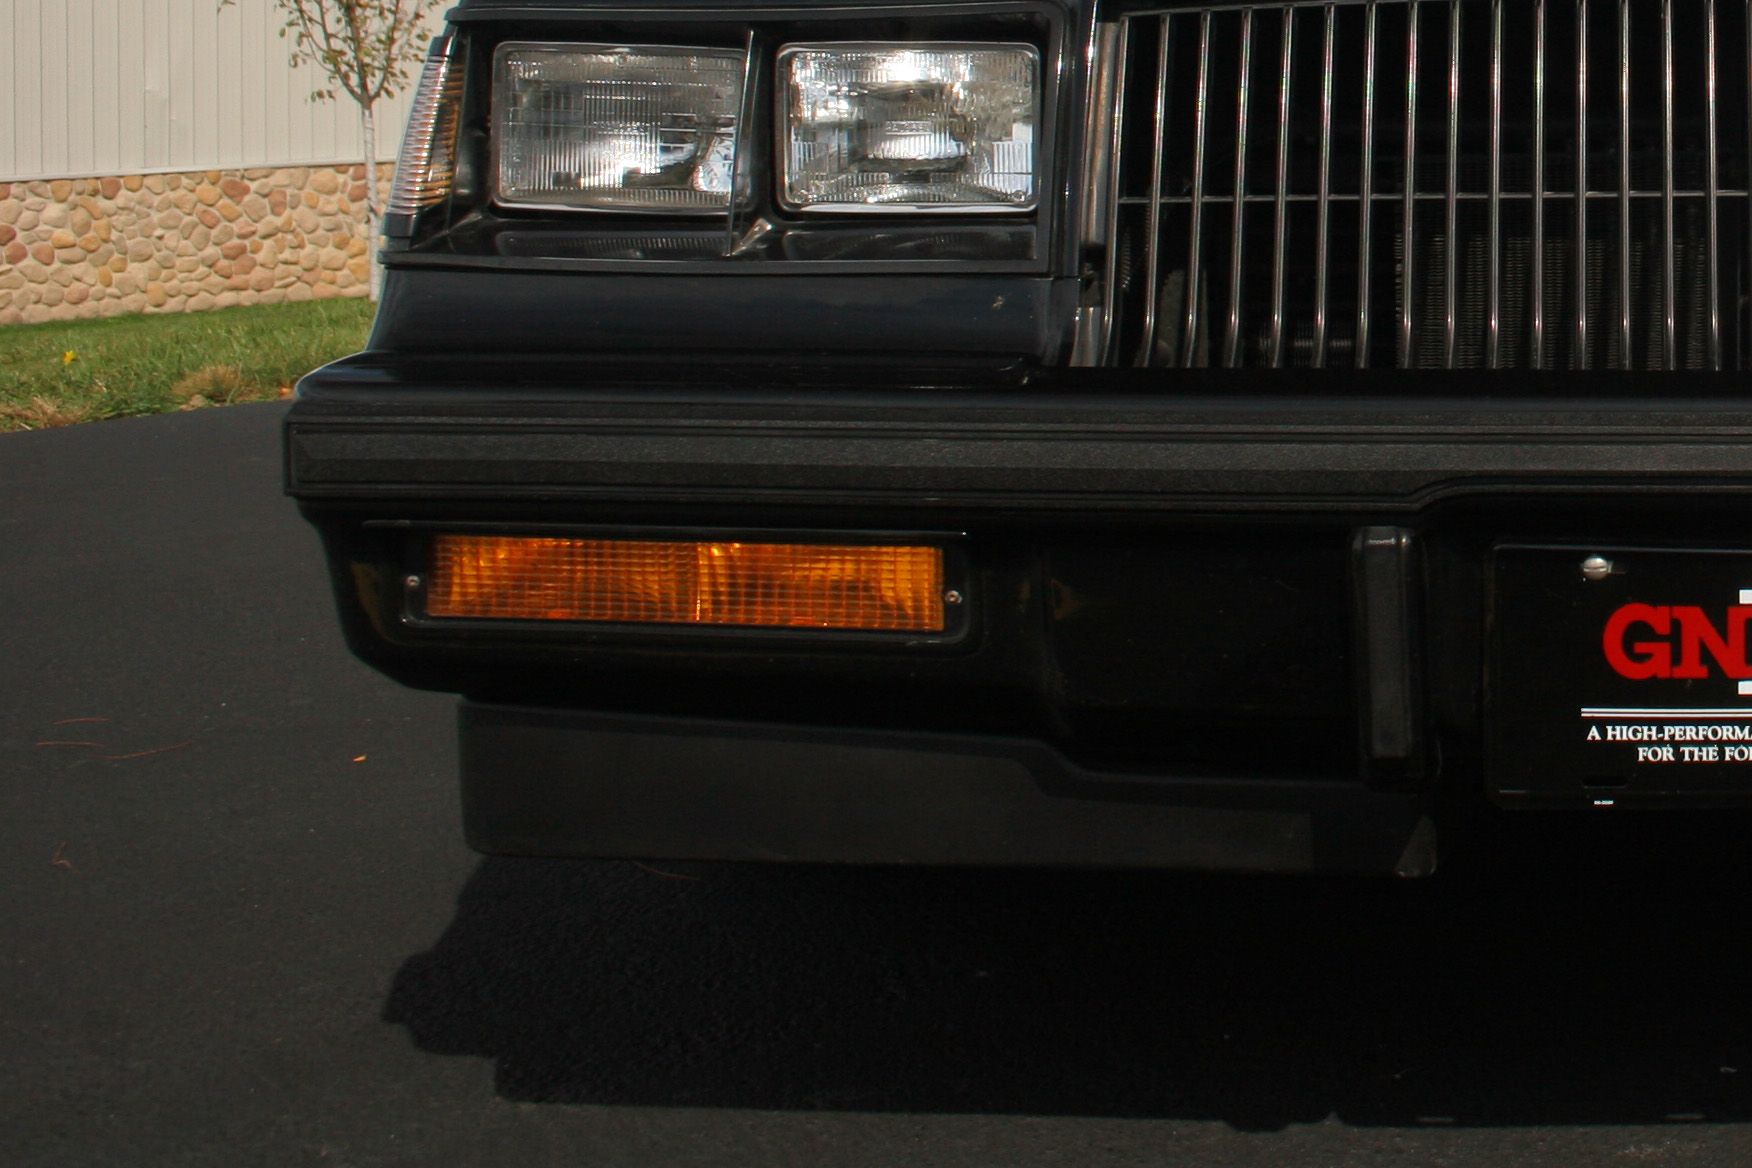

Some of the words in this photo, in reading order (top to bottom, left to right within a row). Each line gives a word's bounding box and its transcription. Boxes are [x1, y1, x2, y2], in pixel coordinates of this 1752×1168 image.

[1587, 725, 1602, 741] A
[1637, 745, 1675, 762] FOR
[1680, 745, 1719, 762] THE
